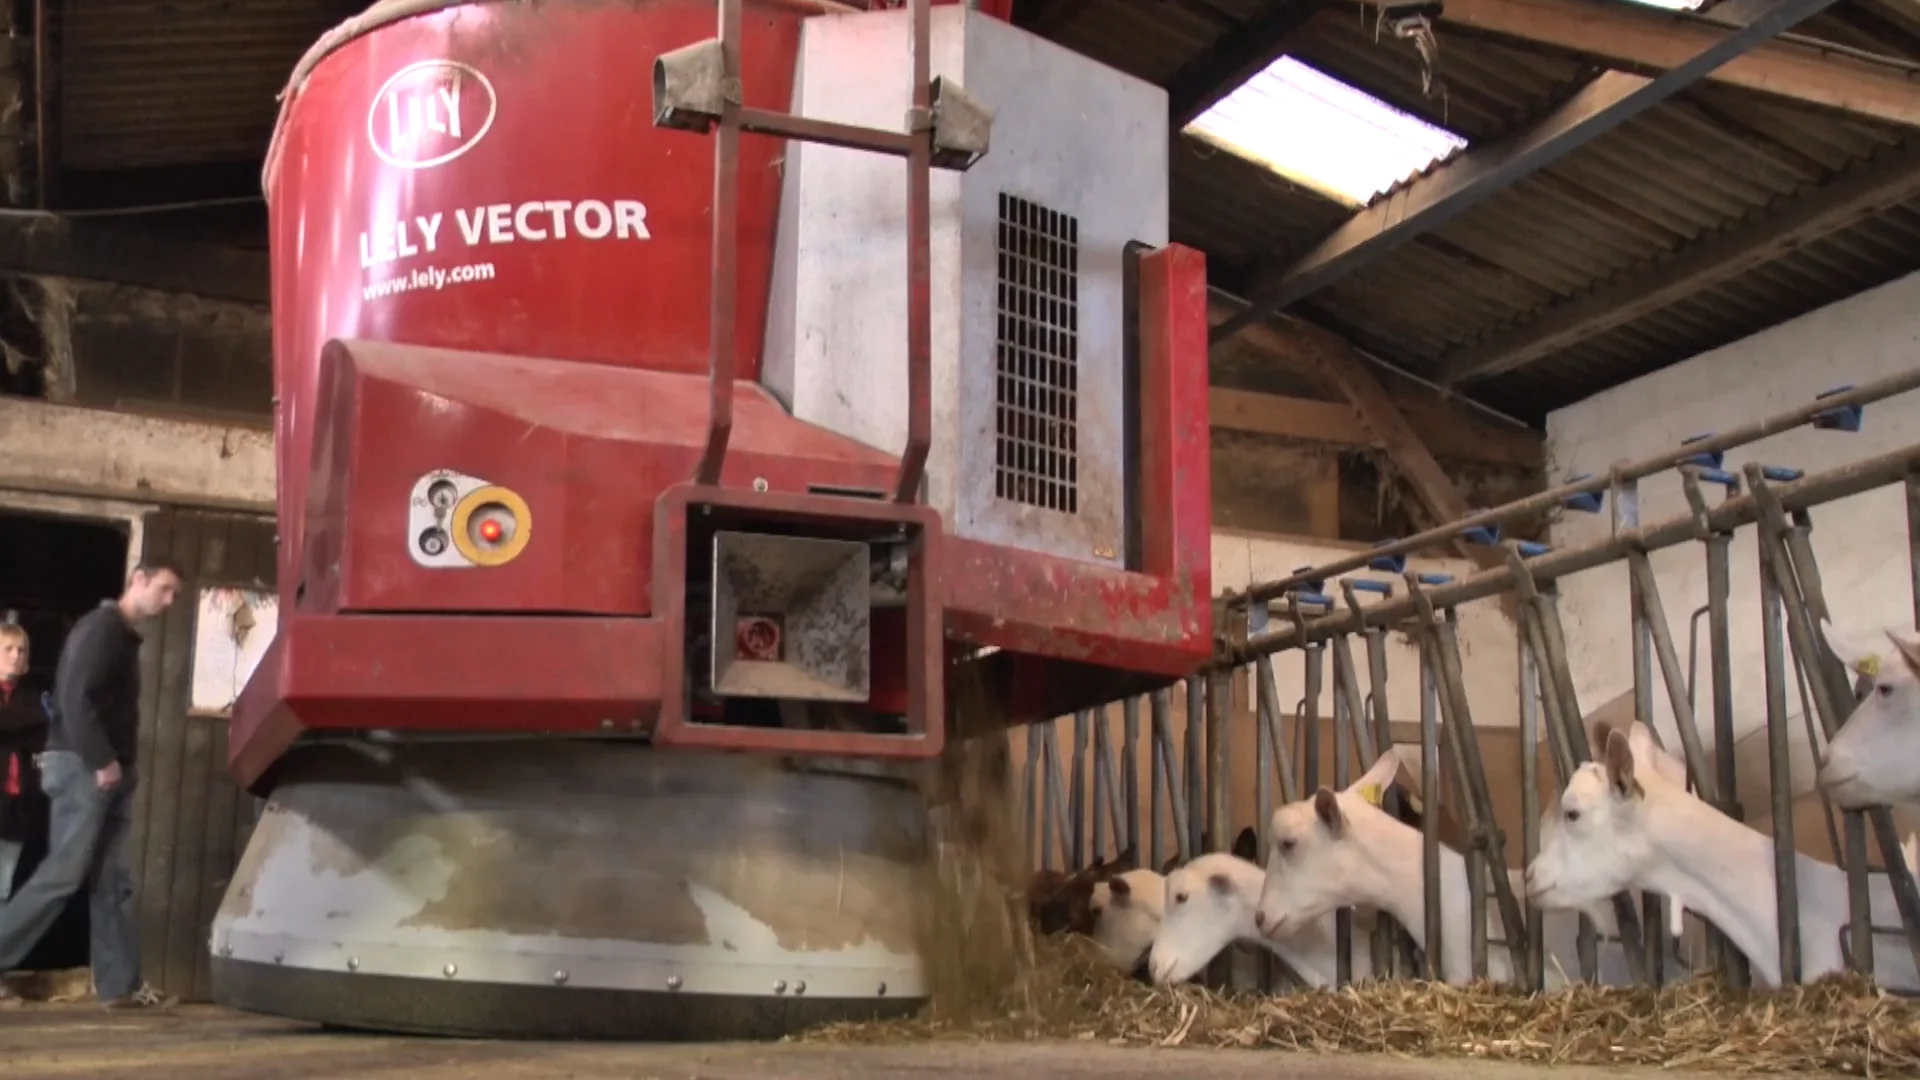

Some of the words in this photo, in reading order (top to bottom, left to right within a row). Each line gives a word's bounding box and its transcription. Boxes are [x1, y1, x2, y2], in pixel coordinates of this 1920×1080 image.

[388, 70, 462, 154] LELY
[359, 212, 443, 269] LELY
[455, 199, 651, 246] VECTOR
[362, 262, 496, 301] www.lely.com
